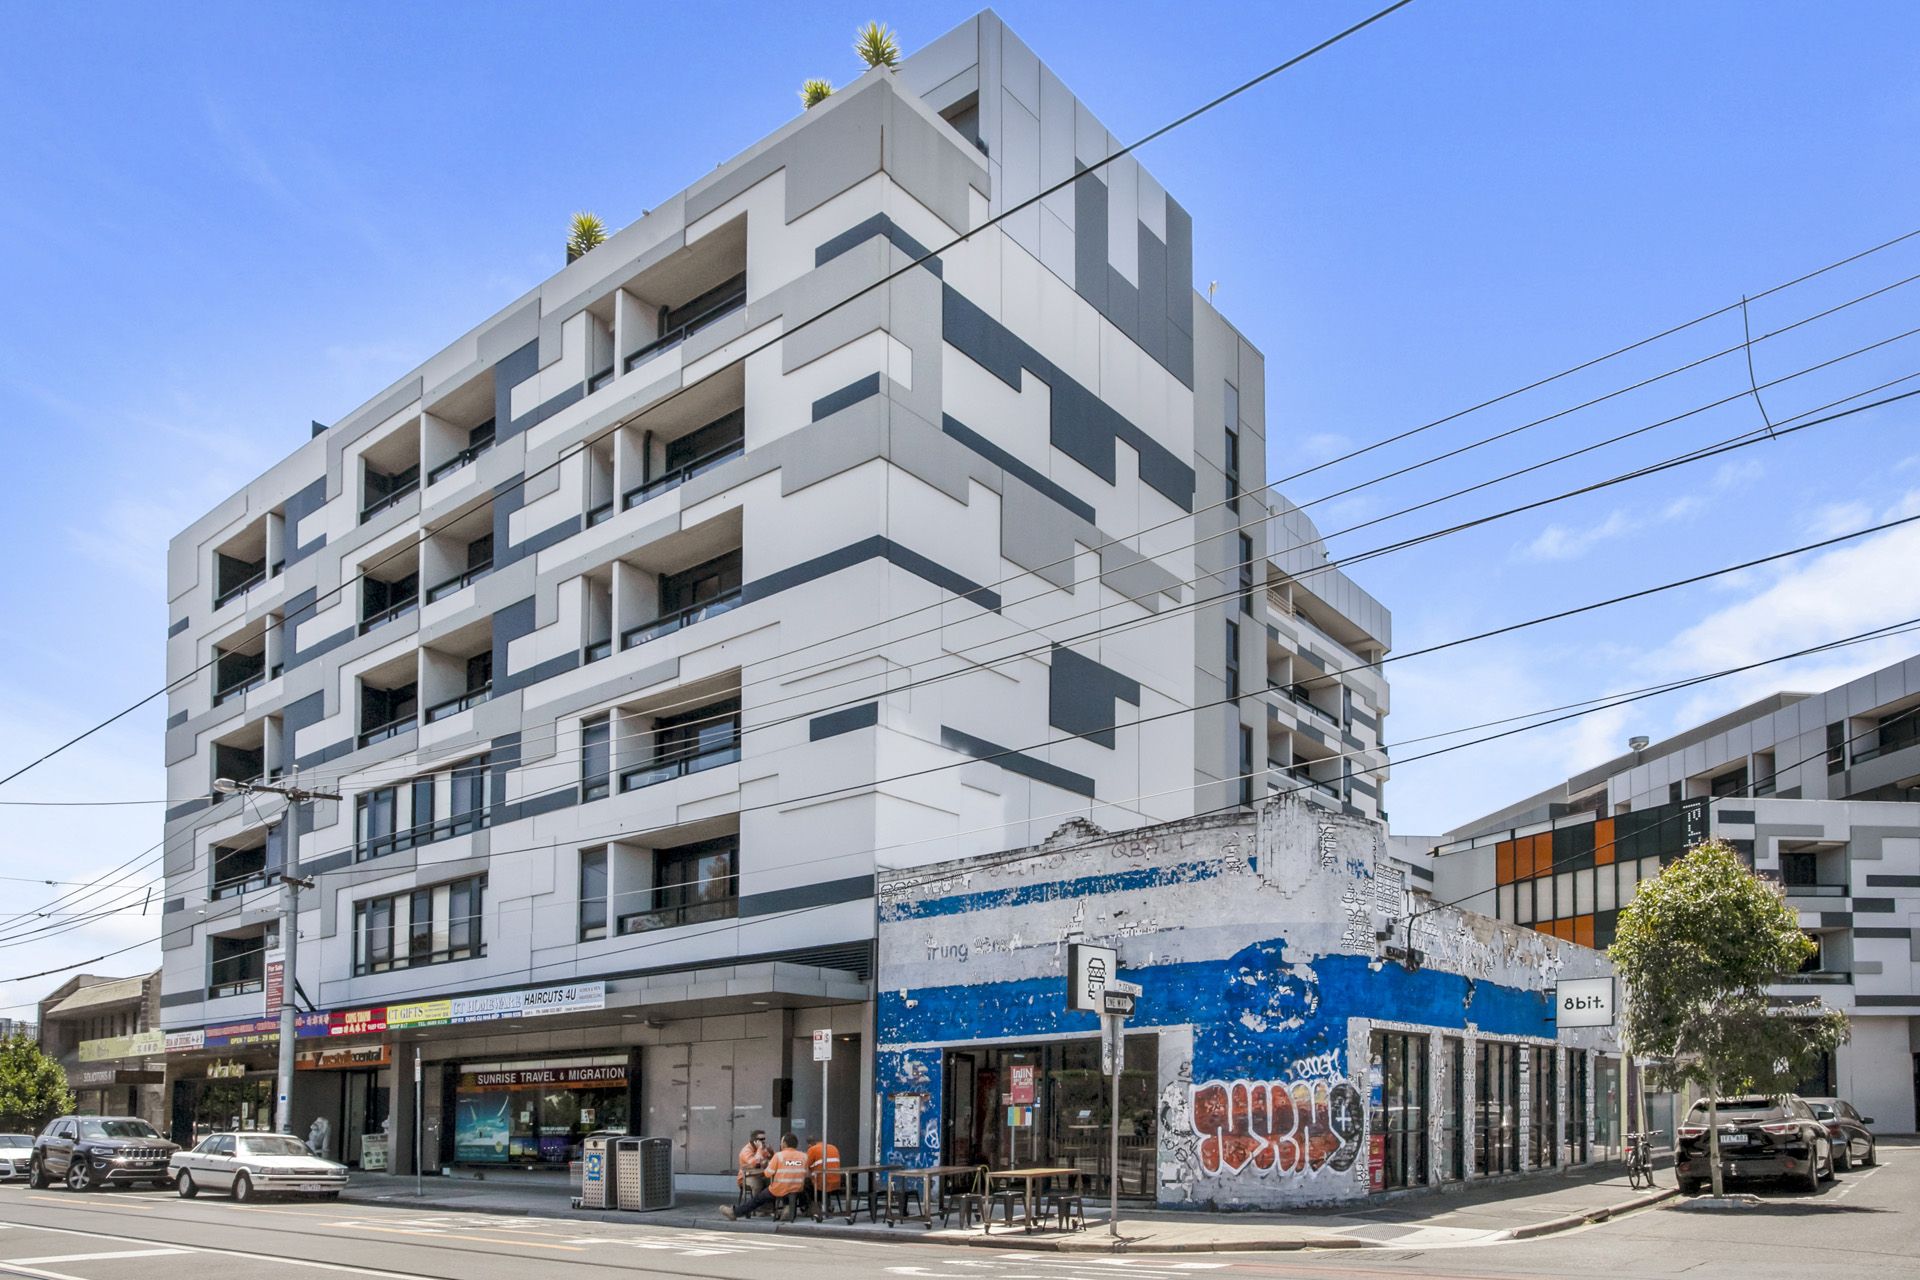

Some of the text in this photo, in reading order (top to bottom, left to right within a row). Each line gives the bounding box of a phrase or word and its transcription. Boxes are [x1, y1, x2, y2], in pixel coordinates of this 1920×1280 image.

[523, 987, 577, 1006] HAIRCUTS 4U
[1107, 997, 1127, 1008] ONE WAY
[1564, 996, 1605, 1010] 8bit.
[388, 1008, 398, 1021] CT
[400, 1006, 423, 1019] GIFTS
[230, 1036, 243, 1045] OPEN
[247, 1034, 259, 1043] DAYS
[477, 1067, 626, 1085] SUNRISE TRAVEL & MIGRATION
[1012, 1067, 1034, 1079] WIN
